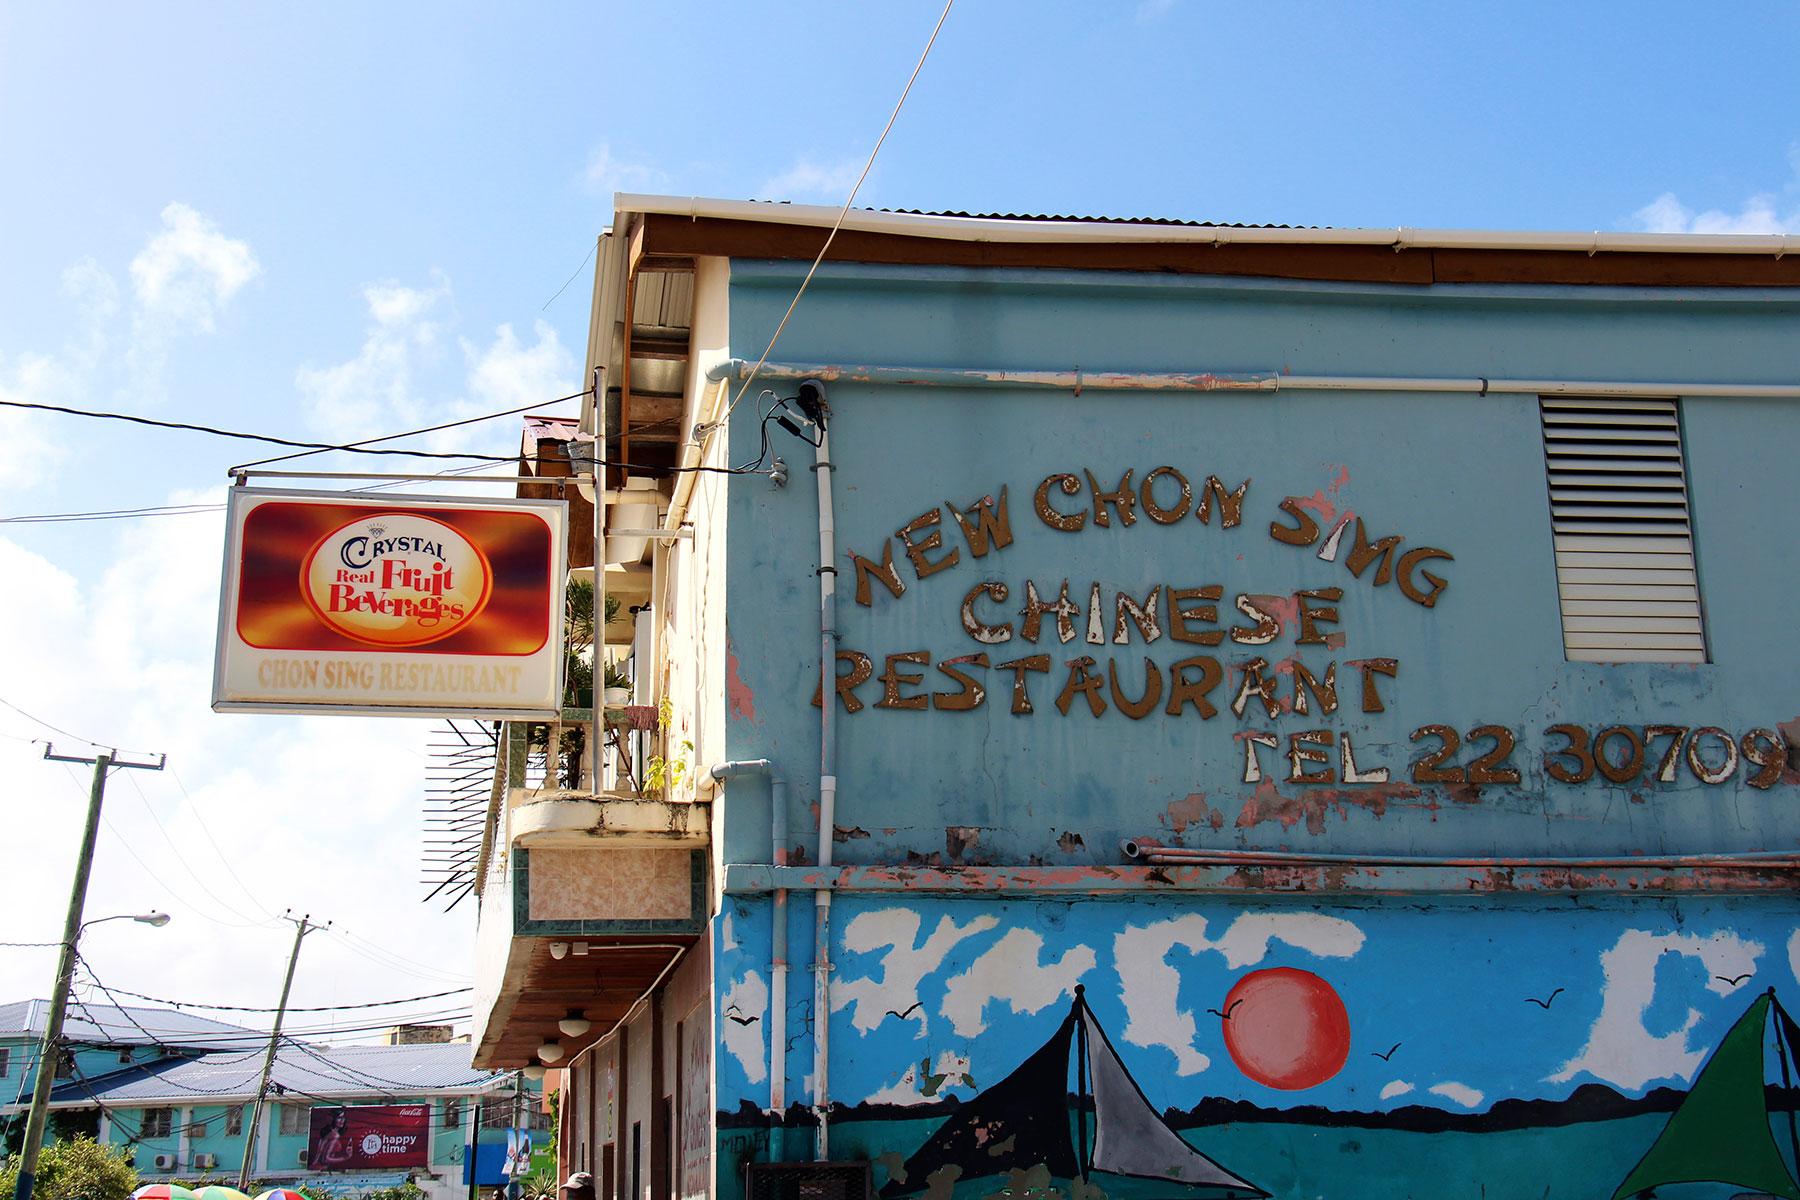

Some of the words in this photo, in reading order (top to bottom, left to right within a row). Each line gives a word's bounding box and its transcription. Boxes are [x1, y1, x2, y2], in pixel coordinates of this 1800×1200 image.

[340, 535, 447, 569] CRYSTAL
[853, 485, 1014, 607] NEW
[1033, 465, 1252, 532] CHON
[1270, 495, 1455, 608] SING
[336, 568, 375, 584] Real
[381, 559, 455, 596] Fruit
[960, 576, 1346, 646] CHINESE
[258, 659, 320, 688] CHON
[324, 661, 374, 690] SING
[379, 662, 522, 694] RESTAURANT
[813, 650, 1399, 720] RESTAURANT
[1240, 729, 1390, 785] TEL
[1408, 724, 1521, 785] 22
[1544, 724, 1789, 789] 30709
[382, 1134, 417, 1145] happy
[382, 1144, 407, 1153] time
